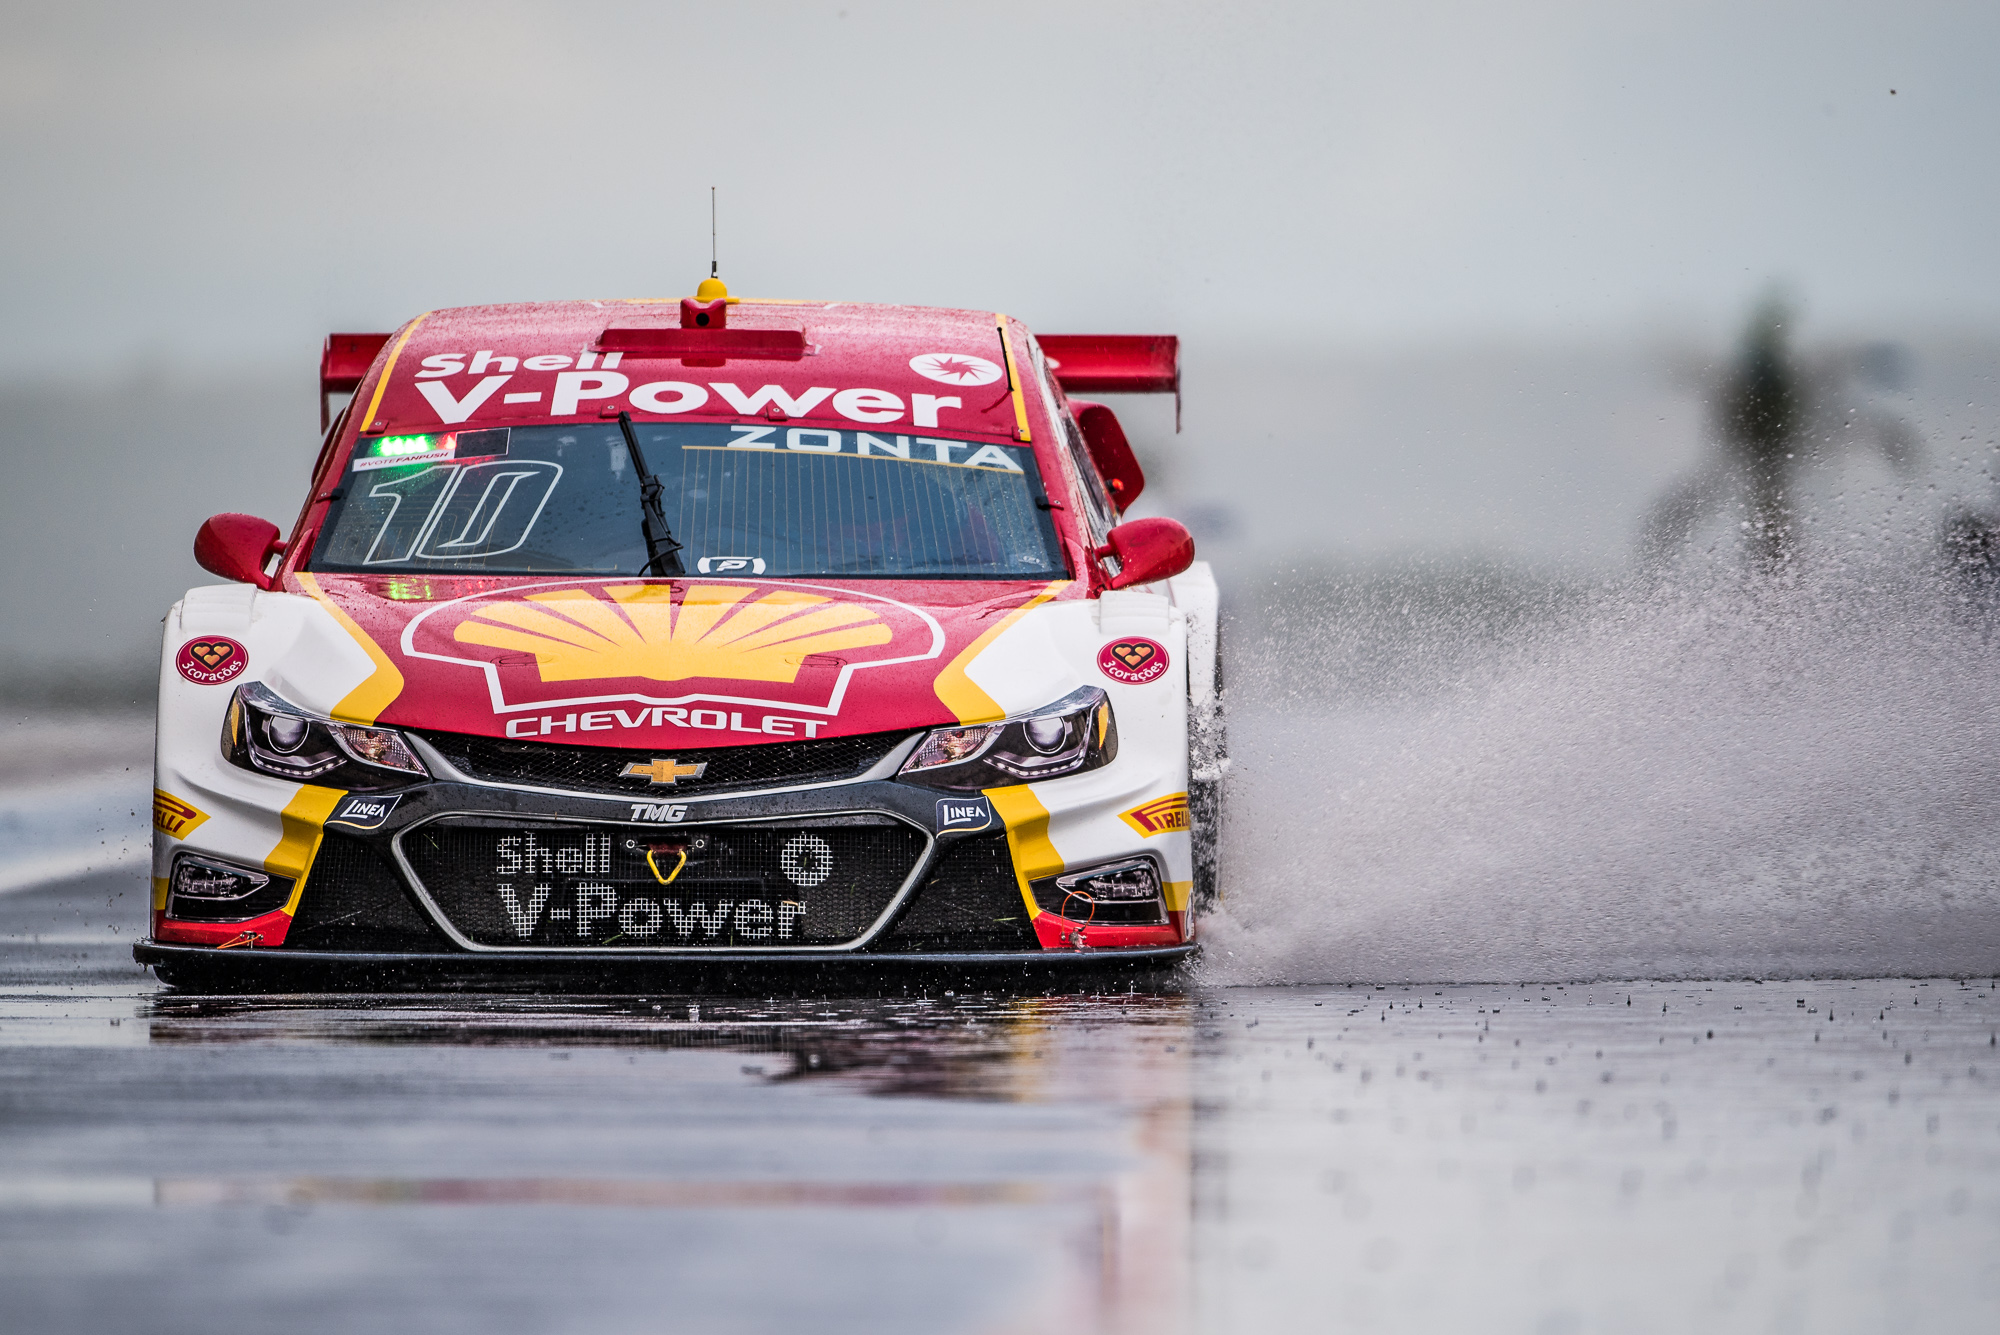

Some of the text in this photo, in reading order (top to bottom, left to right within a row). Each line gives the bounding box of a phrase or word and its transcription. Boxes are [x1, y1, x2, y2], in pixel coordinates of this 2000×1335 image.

[414, 350, 624, 379] Shell
[414, 370, 962, 429] V-Power
[726, 425, 1024, 473] ZONTA
[362, 459, 564, 566] 10
[505, 707, 828, 738] CHEVROLET
[340, 799, 385, 819] LINEA
[630, 803, 688, 822] TMG
[943, 804, 986, 826] LINEA
[496, 832, 611, 875] Shell
[496, 881, 807, 940] V-Power
